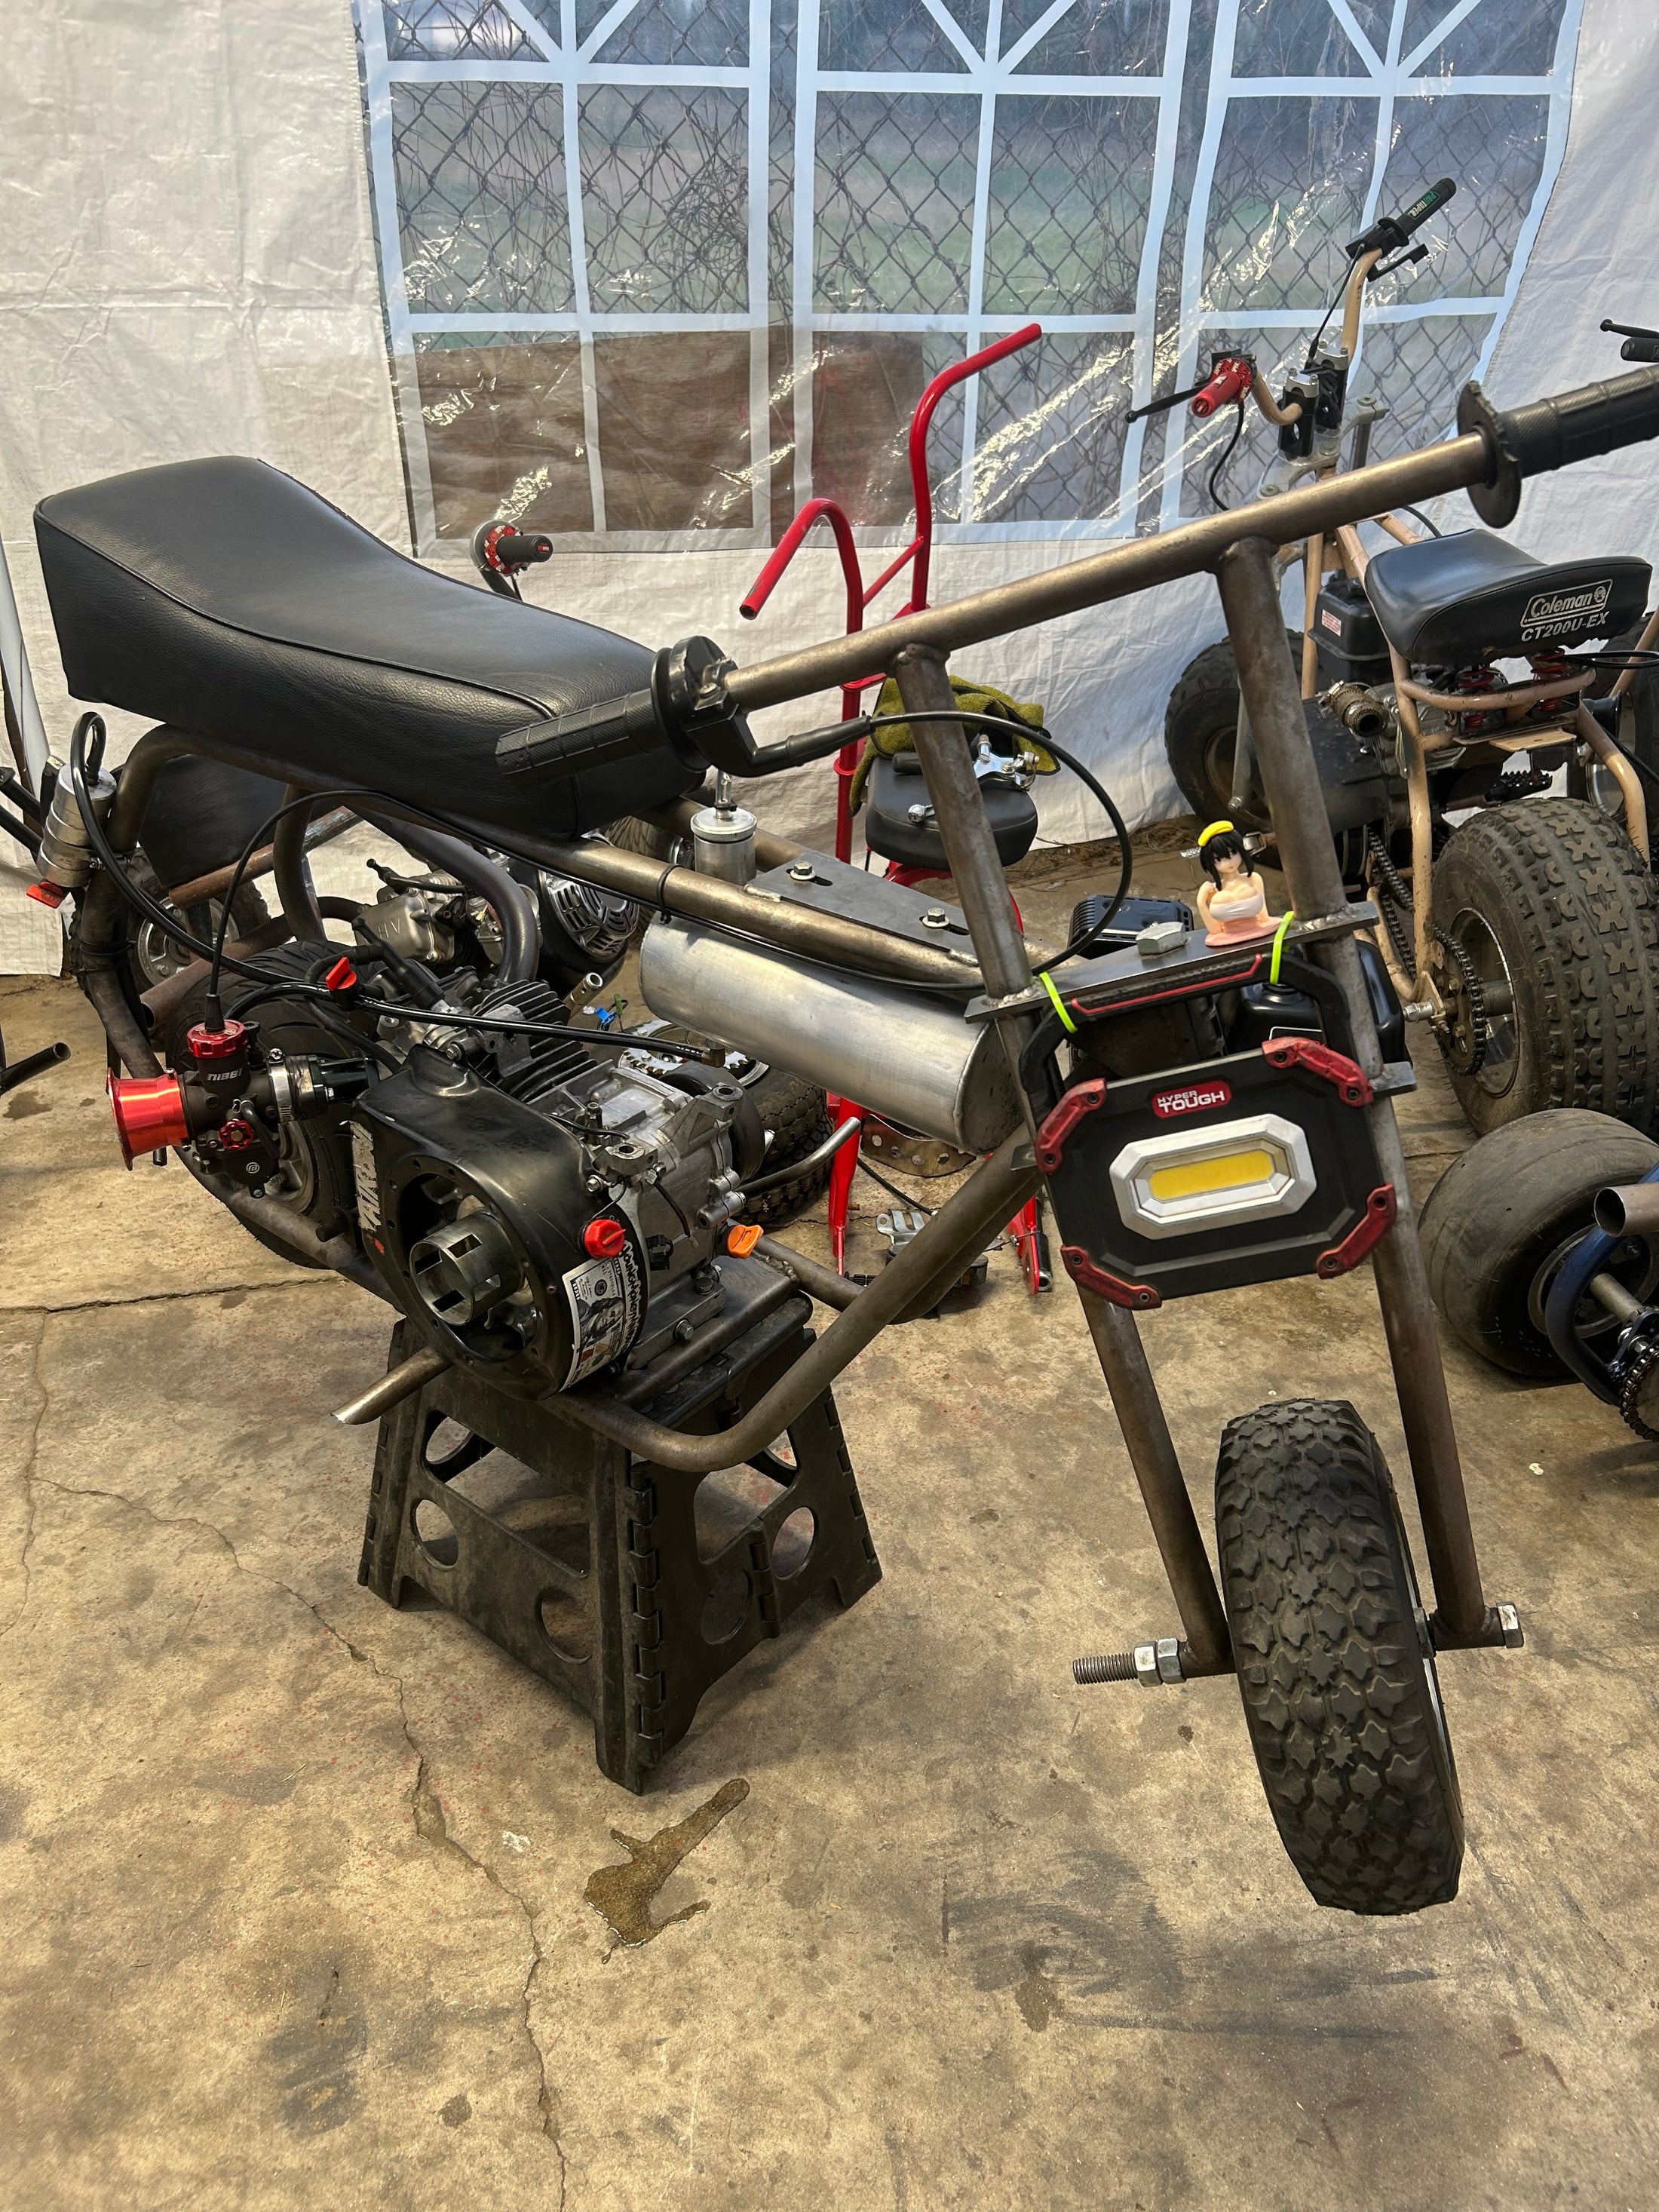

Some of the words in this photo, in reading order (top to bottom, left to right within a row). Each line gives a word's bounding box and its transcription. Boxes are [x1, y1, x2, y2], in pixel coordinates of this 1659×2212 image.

[1531, 592, 1593, 618] Coleman
[1521, 611, 1610, 643] CT200U-EX
[1157, 1091, 1197, 1104] HYPER
[1158, 1091, 1225, 1113] TOUGH
